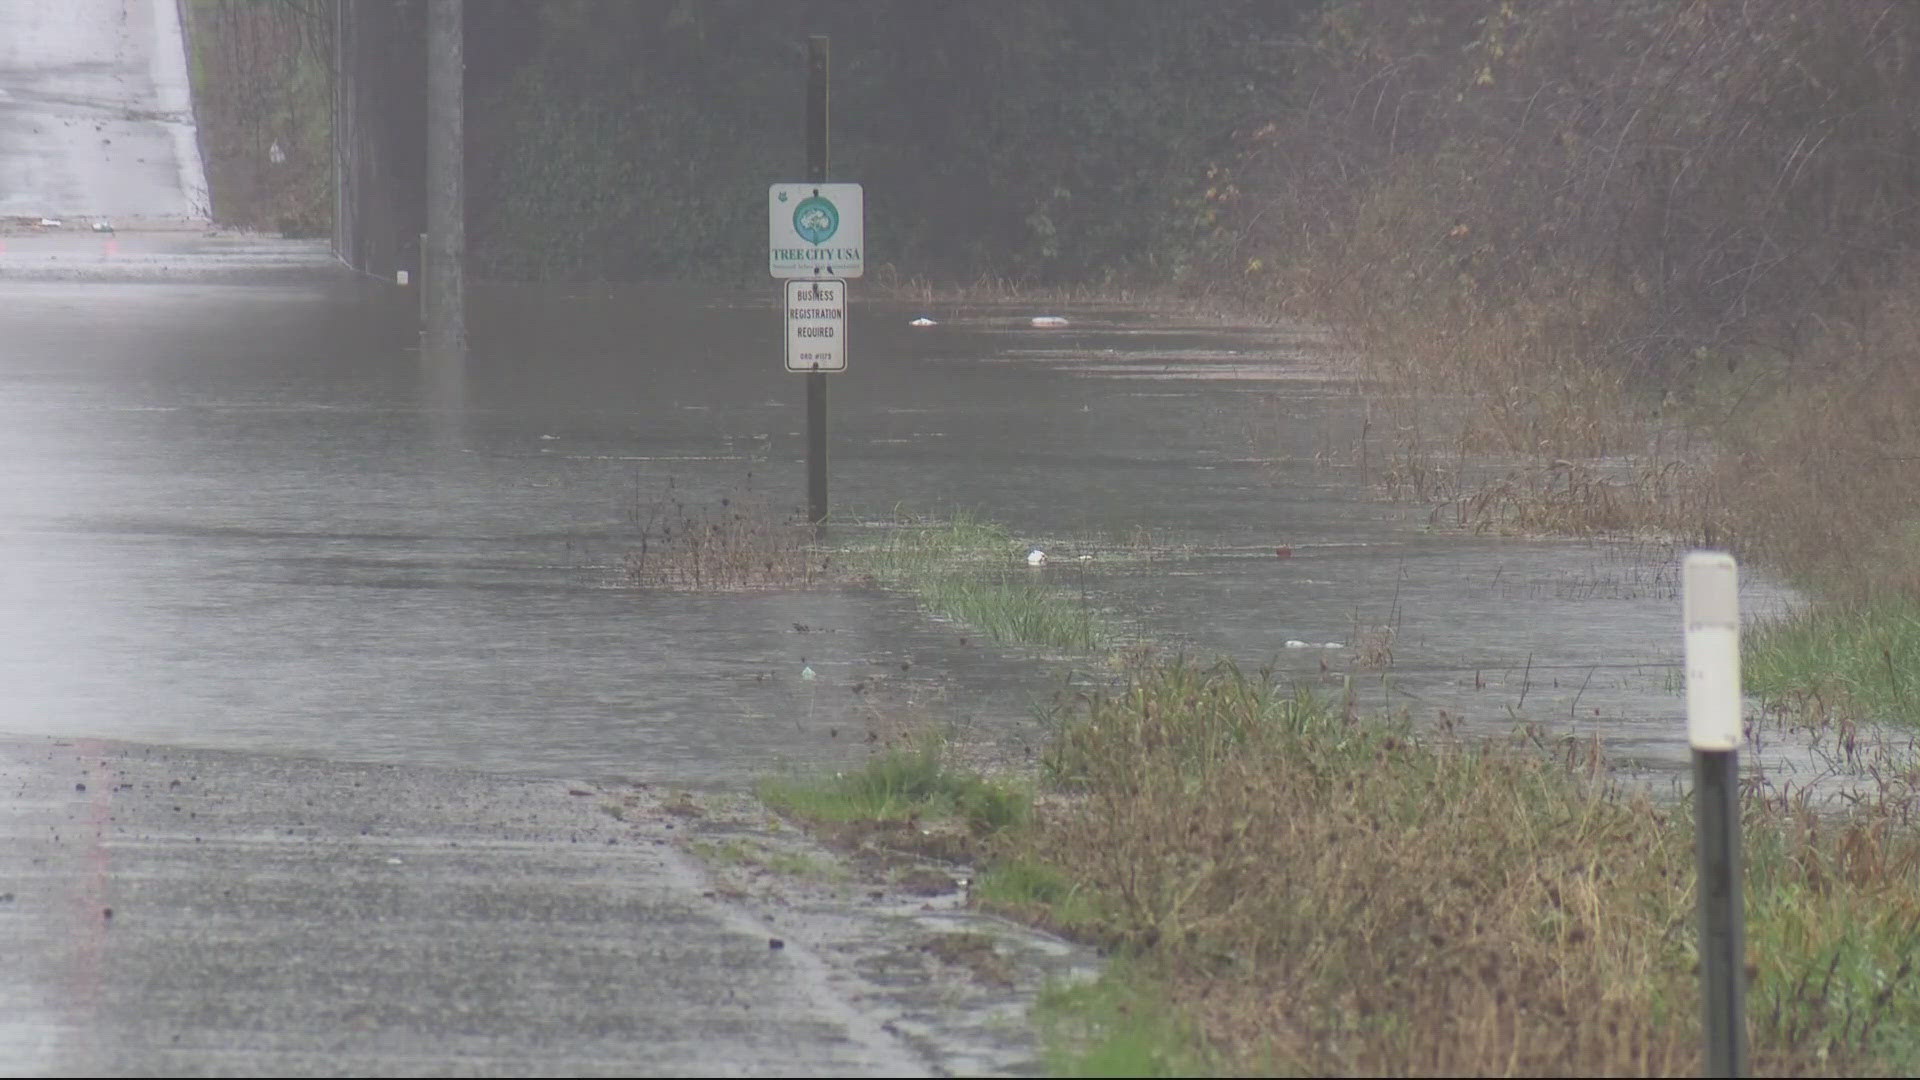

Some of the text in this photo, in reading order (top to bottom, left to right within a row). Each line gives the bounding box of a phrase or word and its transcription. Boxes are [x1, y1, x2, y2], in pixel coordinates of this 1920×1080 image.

[772, 248, 861, 260] TREE CITY USA
[797, 290, 834, 301] BUSINESS
[790, 309, 842, 319] REGISTRATION
[797, 327, 834, 338] REQUIRED
